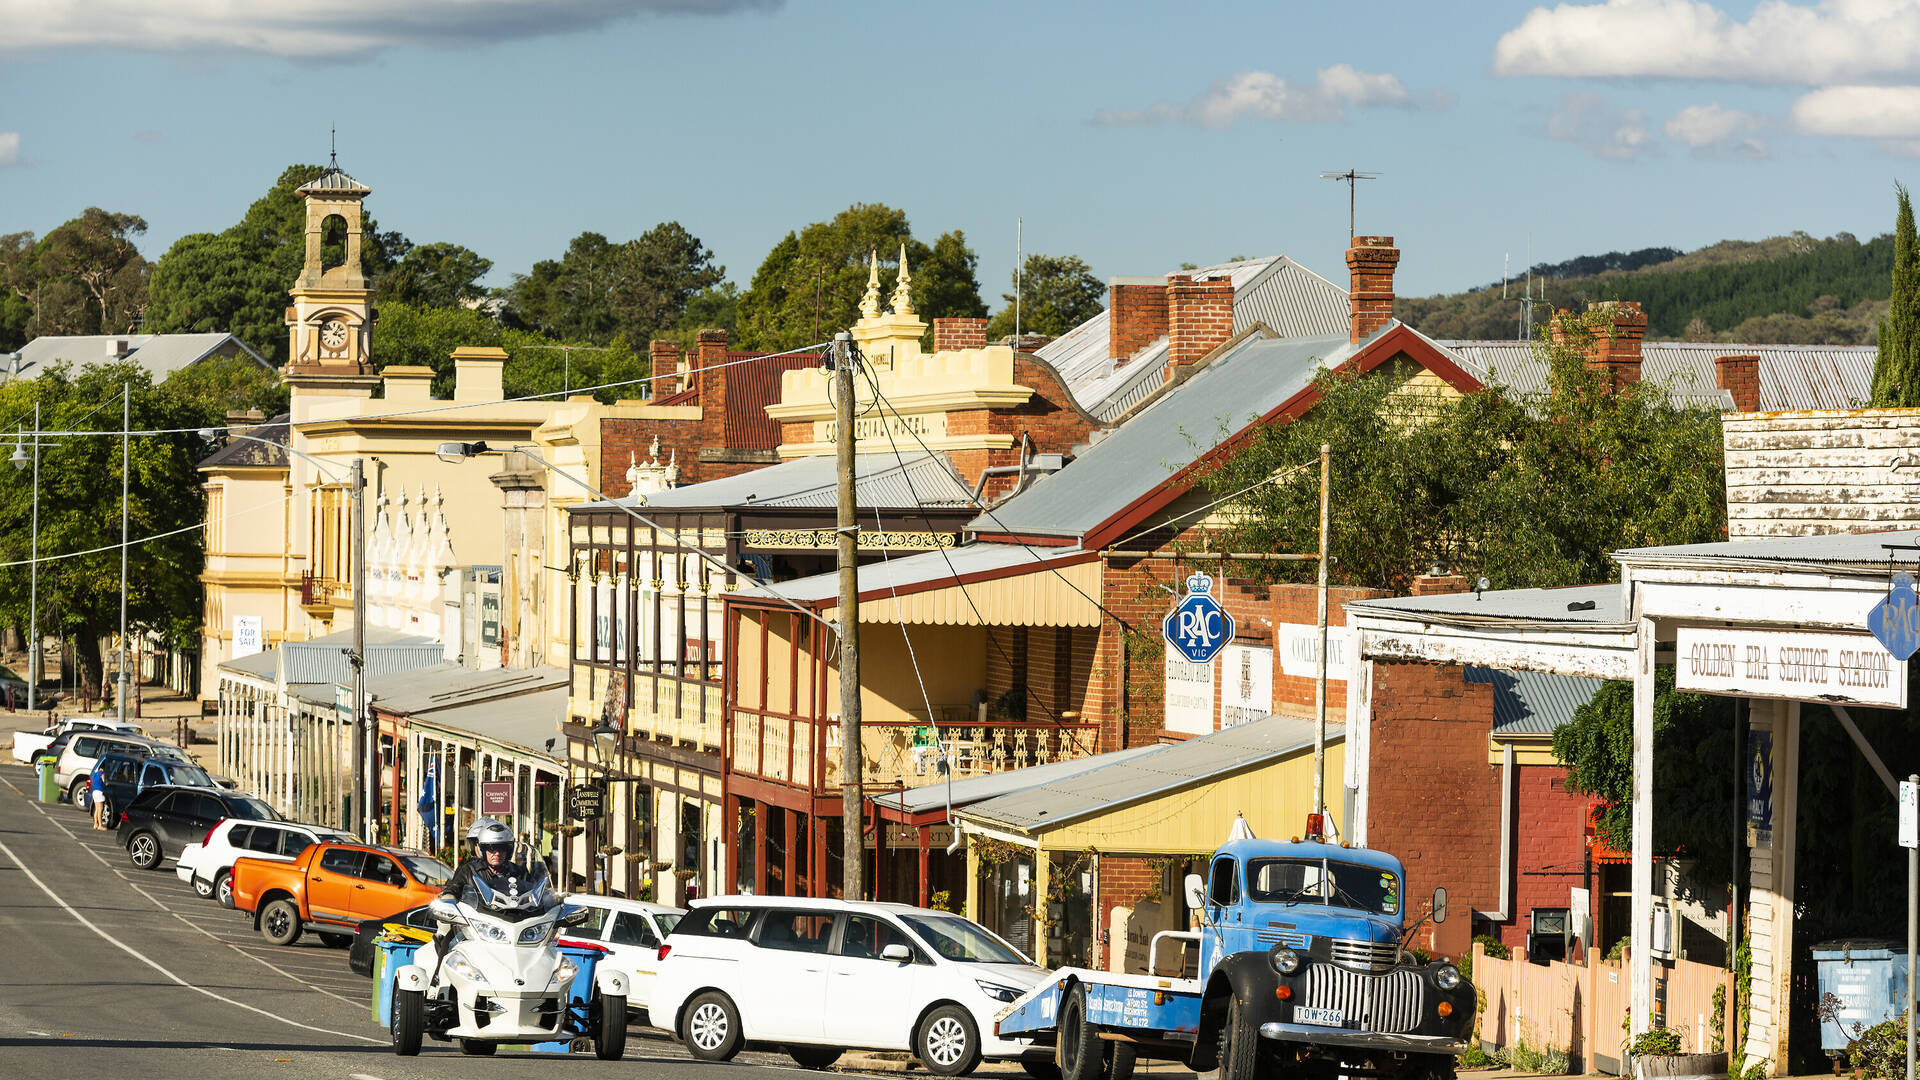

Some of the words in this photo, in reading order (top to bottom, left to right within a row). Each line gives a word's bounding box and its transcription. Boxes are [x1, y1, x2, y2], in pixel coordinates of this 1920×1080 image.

[826, 420, 884, 439] CORCIAL
[1178, 604, 1221, 647] RAC
[240, 629, 255, 637] FOR
[239, 638, 256, 646] SALE
[1191, 649, 1207, 657] VIC
[1691, 642, 1736, 678] GOLDEN
[1746, 645, 1769, 680] ERA
[1779, 646, 1829, 684] SERVICE
[1839, 649, 1890, 689] STATION
[575, 788, 599, 799] TANSWELLS
[570, 797, 599, 807] COMMERCIAL
[580, 806, 595, 817] HOTEL
